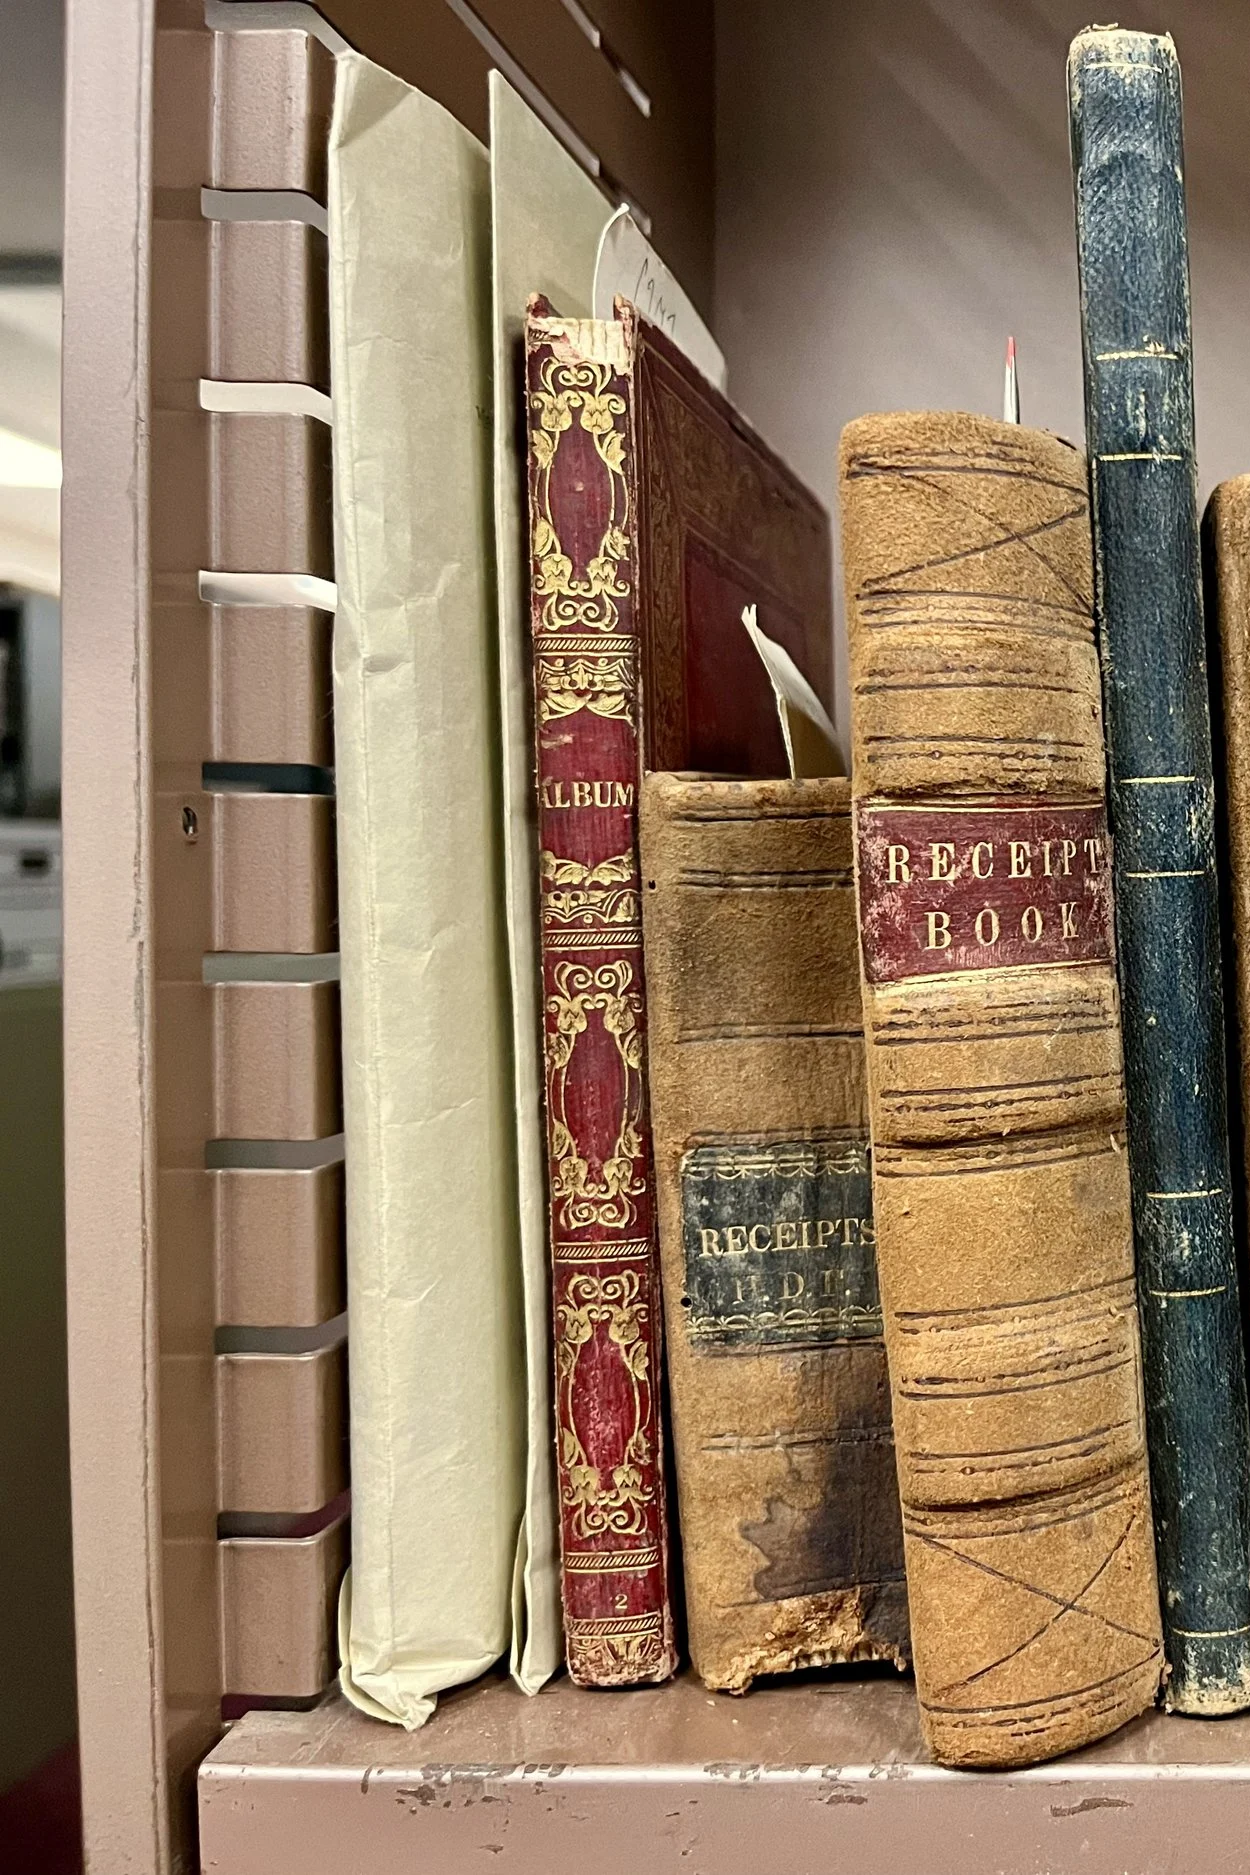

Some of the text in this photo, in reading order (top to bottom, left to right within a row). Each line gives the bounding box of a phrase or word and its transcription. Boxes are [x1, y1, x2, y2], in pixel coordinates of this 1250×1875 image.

[542, 780, 635, 809] ALBUM
[886, 839, 1102, 883] RECEIPT
[924, 901, 1079, 950] BOOK
[699, 1217, 876, 1257] RECEIPTS
[615, 1593, 628, 1609] 2
